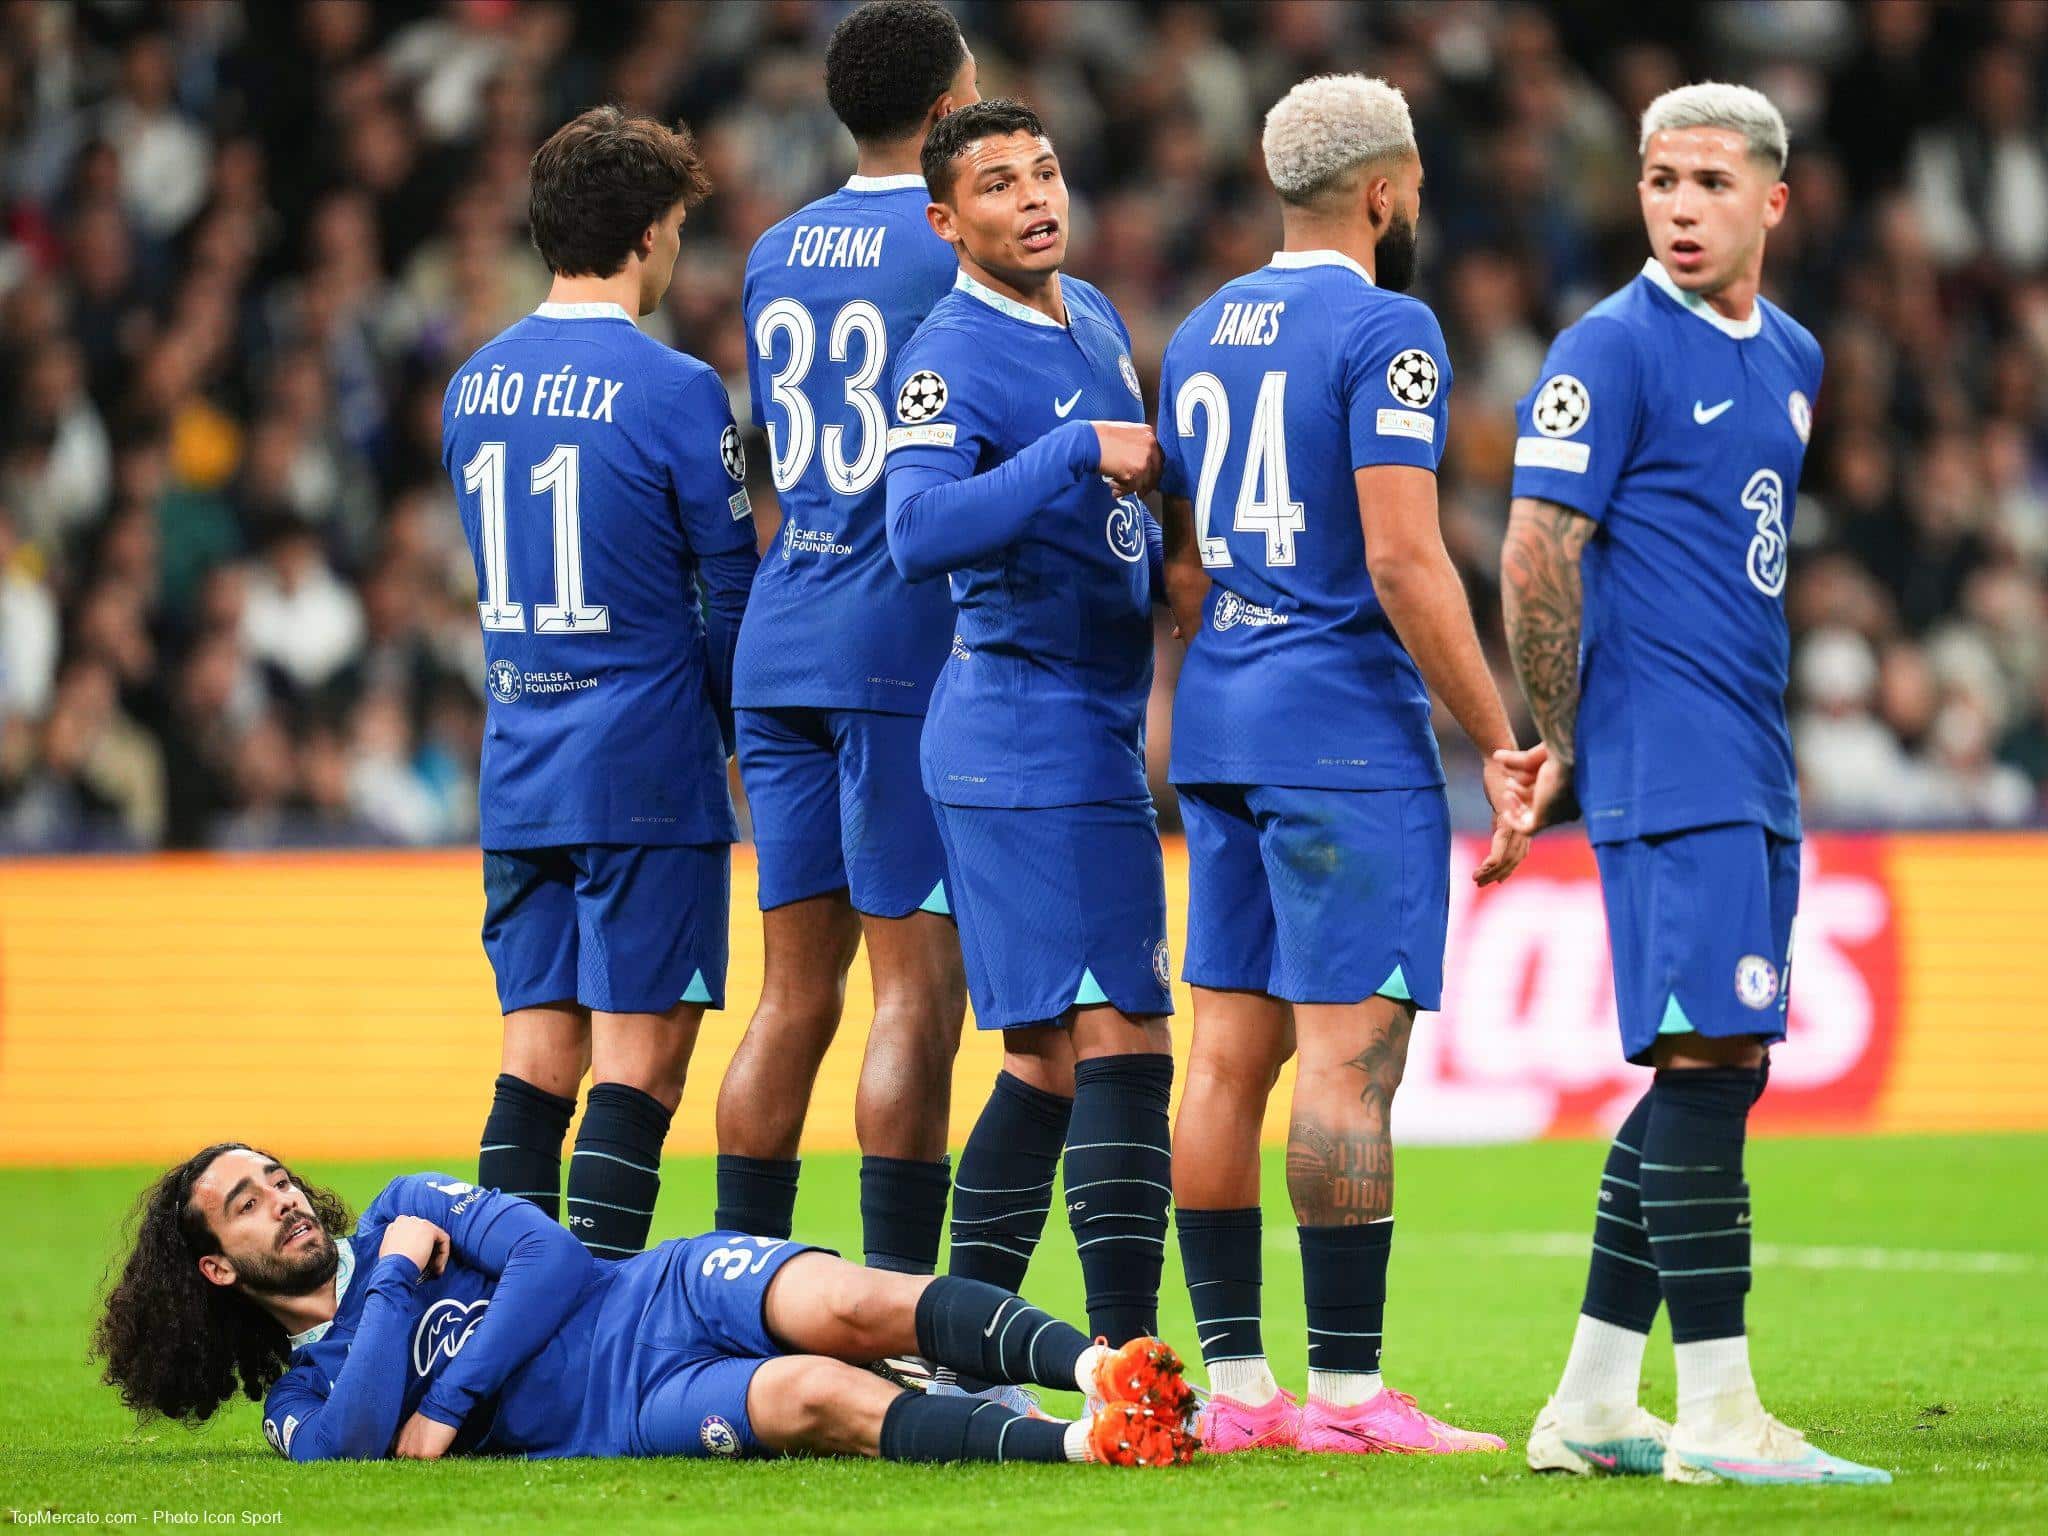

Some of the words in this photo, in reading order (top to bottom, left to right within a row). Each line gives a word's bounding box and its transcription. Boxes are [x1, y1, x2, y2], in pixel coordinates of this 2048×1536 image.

[787, 226, 886, 267] FOFANA
[1210, 302, 1285, 346] JAMES
[455, 364, 524, 418] JOÃO
[532, 365, 624, 423] FÉLIX
[755, 297, 888, 495] 33
[1176, 371, 1306, 568] 24
[463, 442, 610, 634] 11
[524, 672, 573, 682] CHELSEA
[525, 678, 598, 693] FOUNDATION
[569, 1215, 595, 1228] CFC
